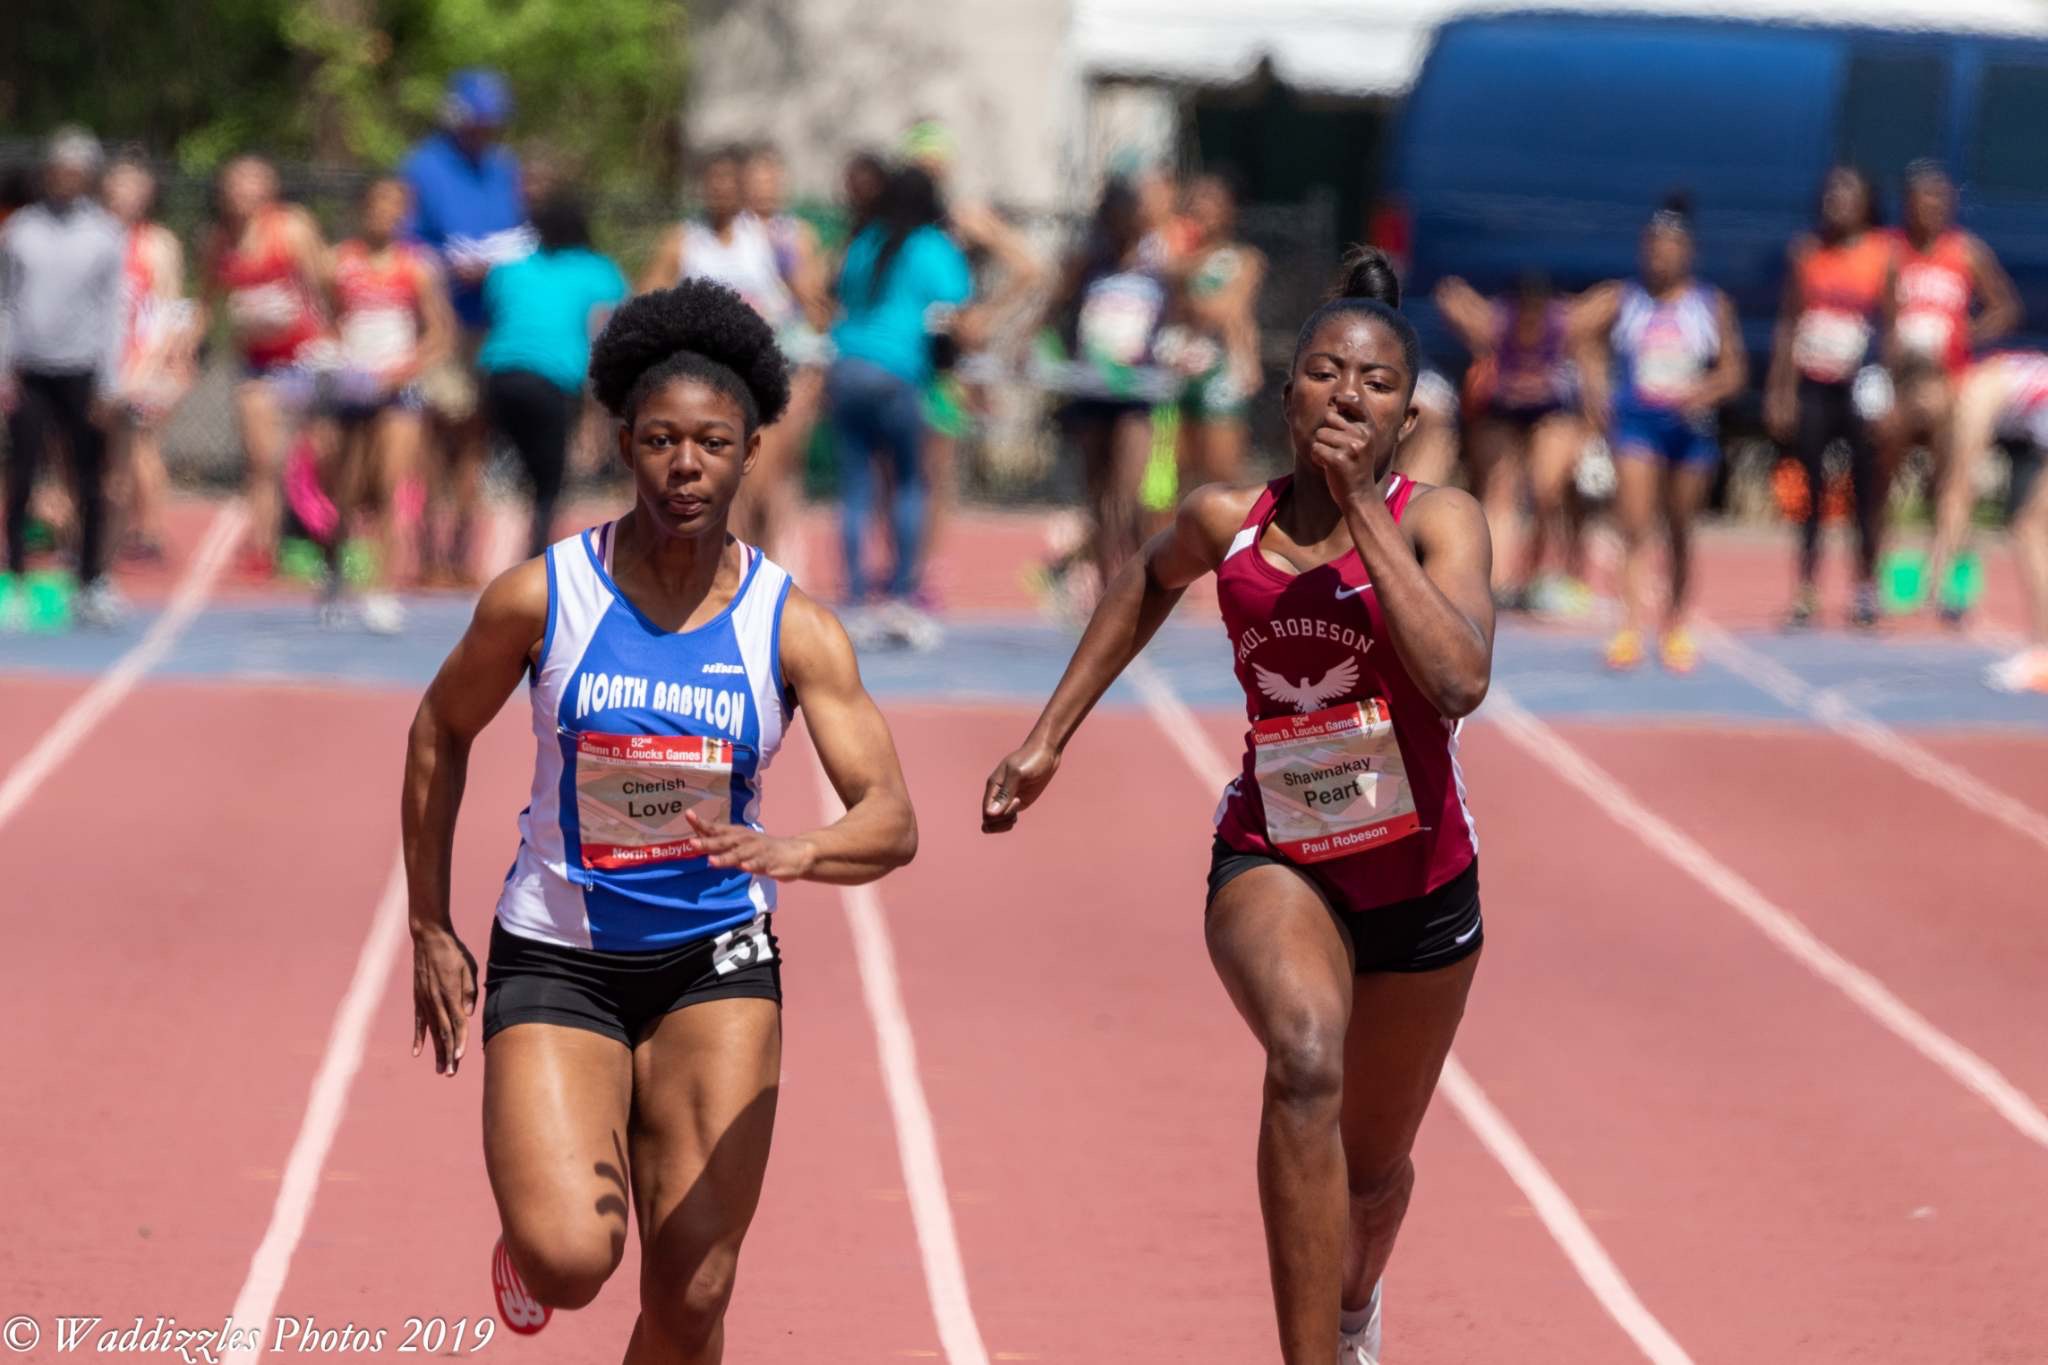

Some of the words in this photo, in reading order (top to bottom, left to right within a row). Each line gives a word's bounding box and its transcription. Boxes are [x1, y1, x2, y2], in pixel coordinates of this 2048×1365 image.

[1270, 618, 1375, 654] ROBESON
[576, 672, 648, 719] NORTH
[653, 681, 745, 740] BABYLON
[1281, 728, 1293, 739] D.
[1325, 716, 1360, 731] Games
[612, 746, 623, 758] D.
[626, 748, 663, 760] Loucks
[666, 749, 701, 762] Games
[1283, 757, 1371, 786] Shawnakay
[622, 777, 686, 795] Cherish
[1304, 780, 1362, 808] Peart
[627, 799, 682, 818] Love
[612, 847, 647, 860] North
[651, 841, 694, 858] Babylo
[1302, 840, 1329, 854] Paul
[1332, 825, 1388, 847] Robeson
